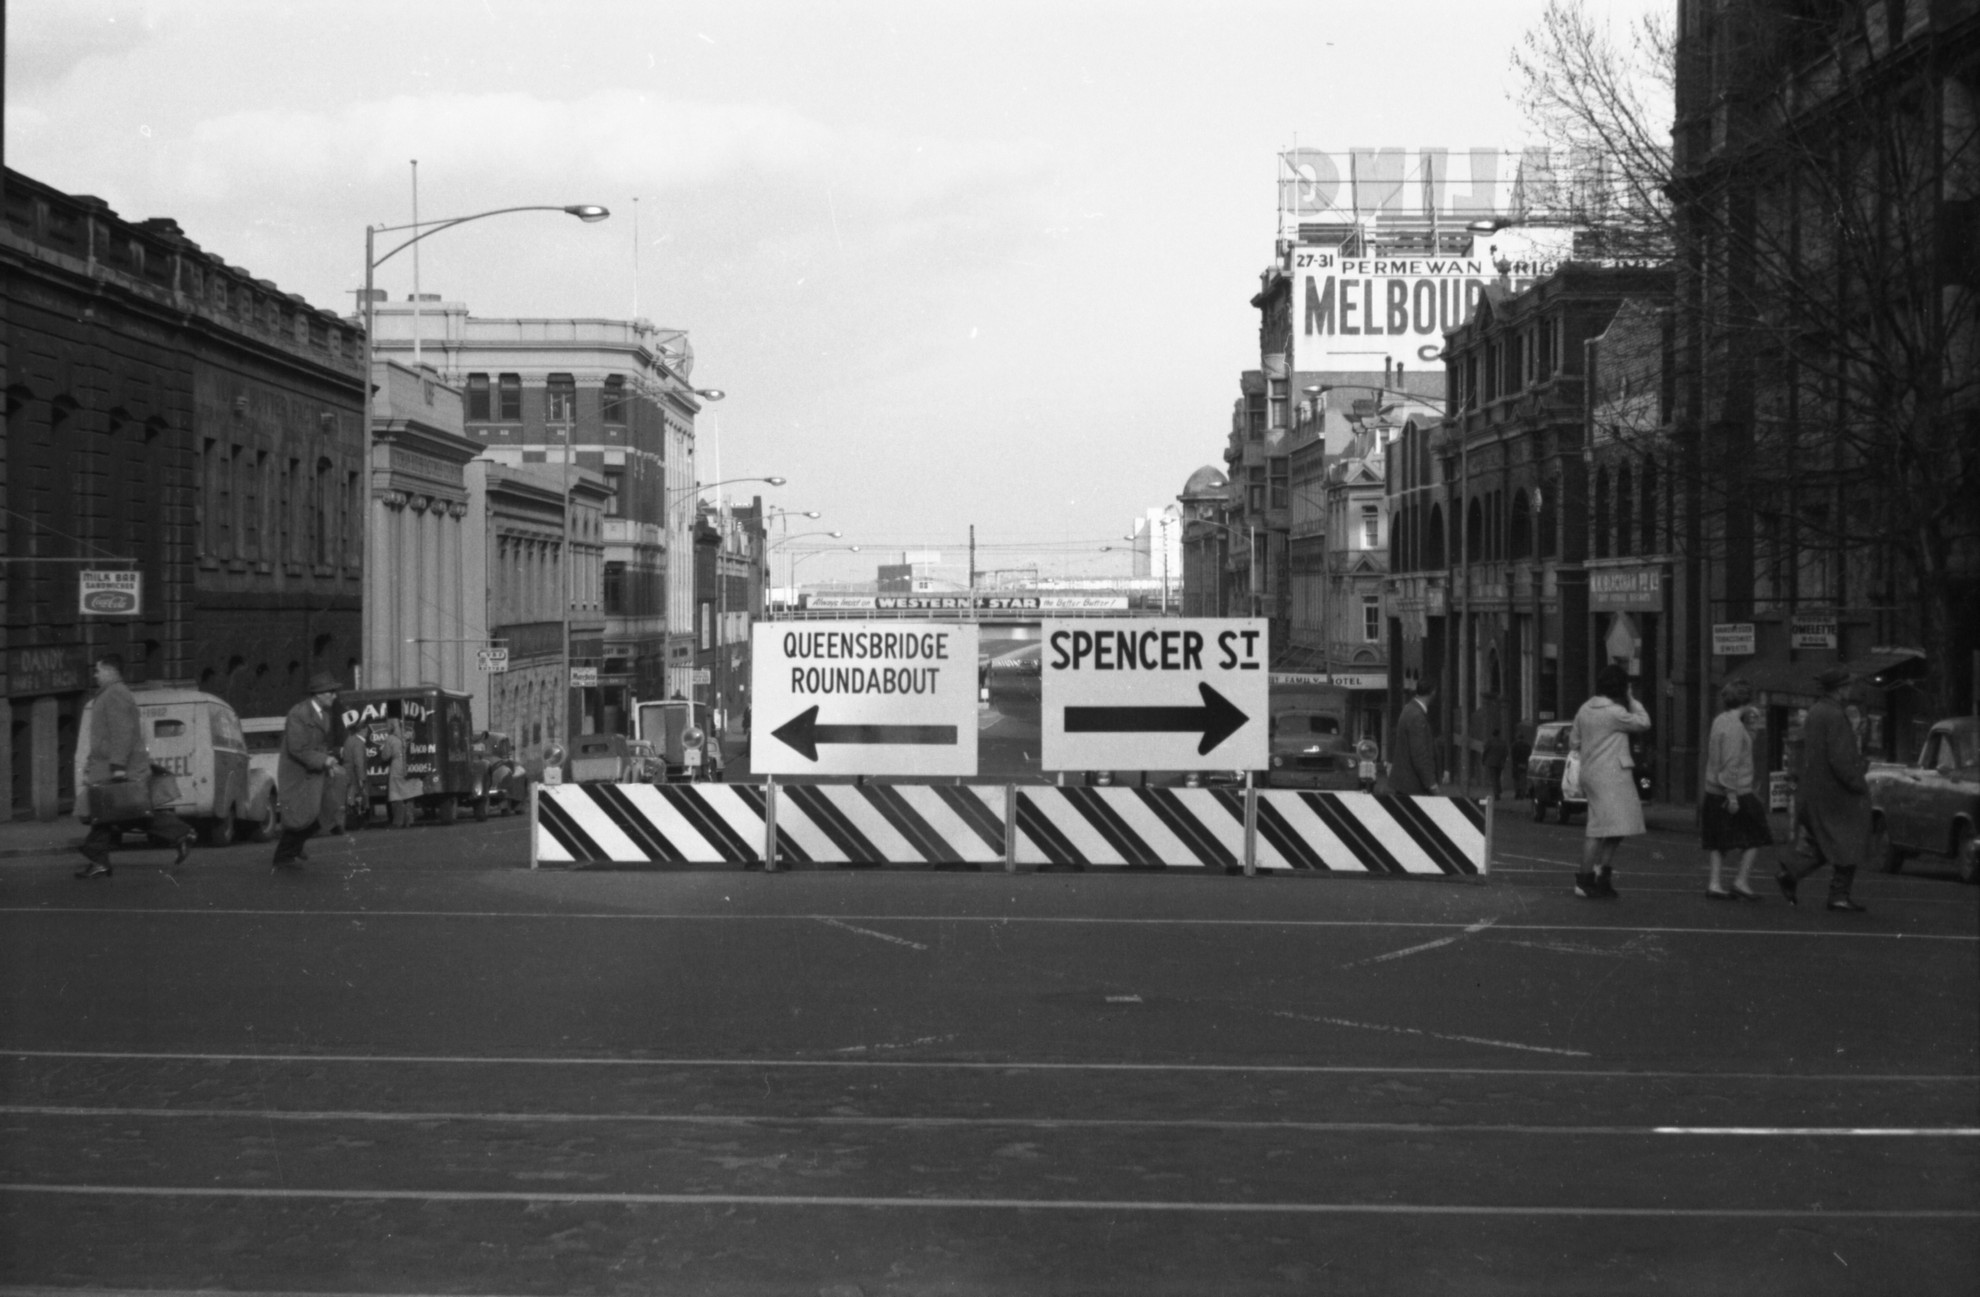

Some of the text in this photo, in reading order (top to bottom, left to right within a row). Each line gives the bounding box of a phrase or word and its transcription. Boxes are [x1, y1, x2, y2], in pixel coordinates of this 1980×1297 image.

[1296, 254, 1334, 268] 27-31
[1341, 261, 1482, 274] PERMEWAN
[83, 572, 136, 582] MILK BAR
[85, 582, 135, 590] SANDWICHES
[878, 598, 971, 608] WESTERN
[989, 598, 1037, 608] STAR
[1791, 624, 1837, 635] OMELETTE
[783, 631, 949, 660] QUEENSBRIDGE
[1050, 630, 1260, 671] SPENCER ST
[791, 667, 939, 695] ROUNDABOUT
[1331, 677, 1362, 685] OTEL
